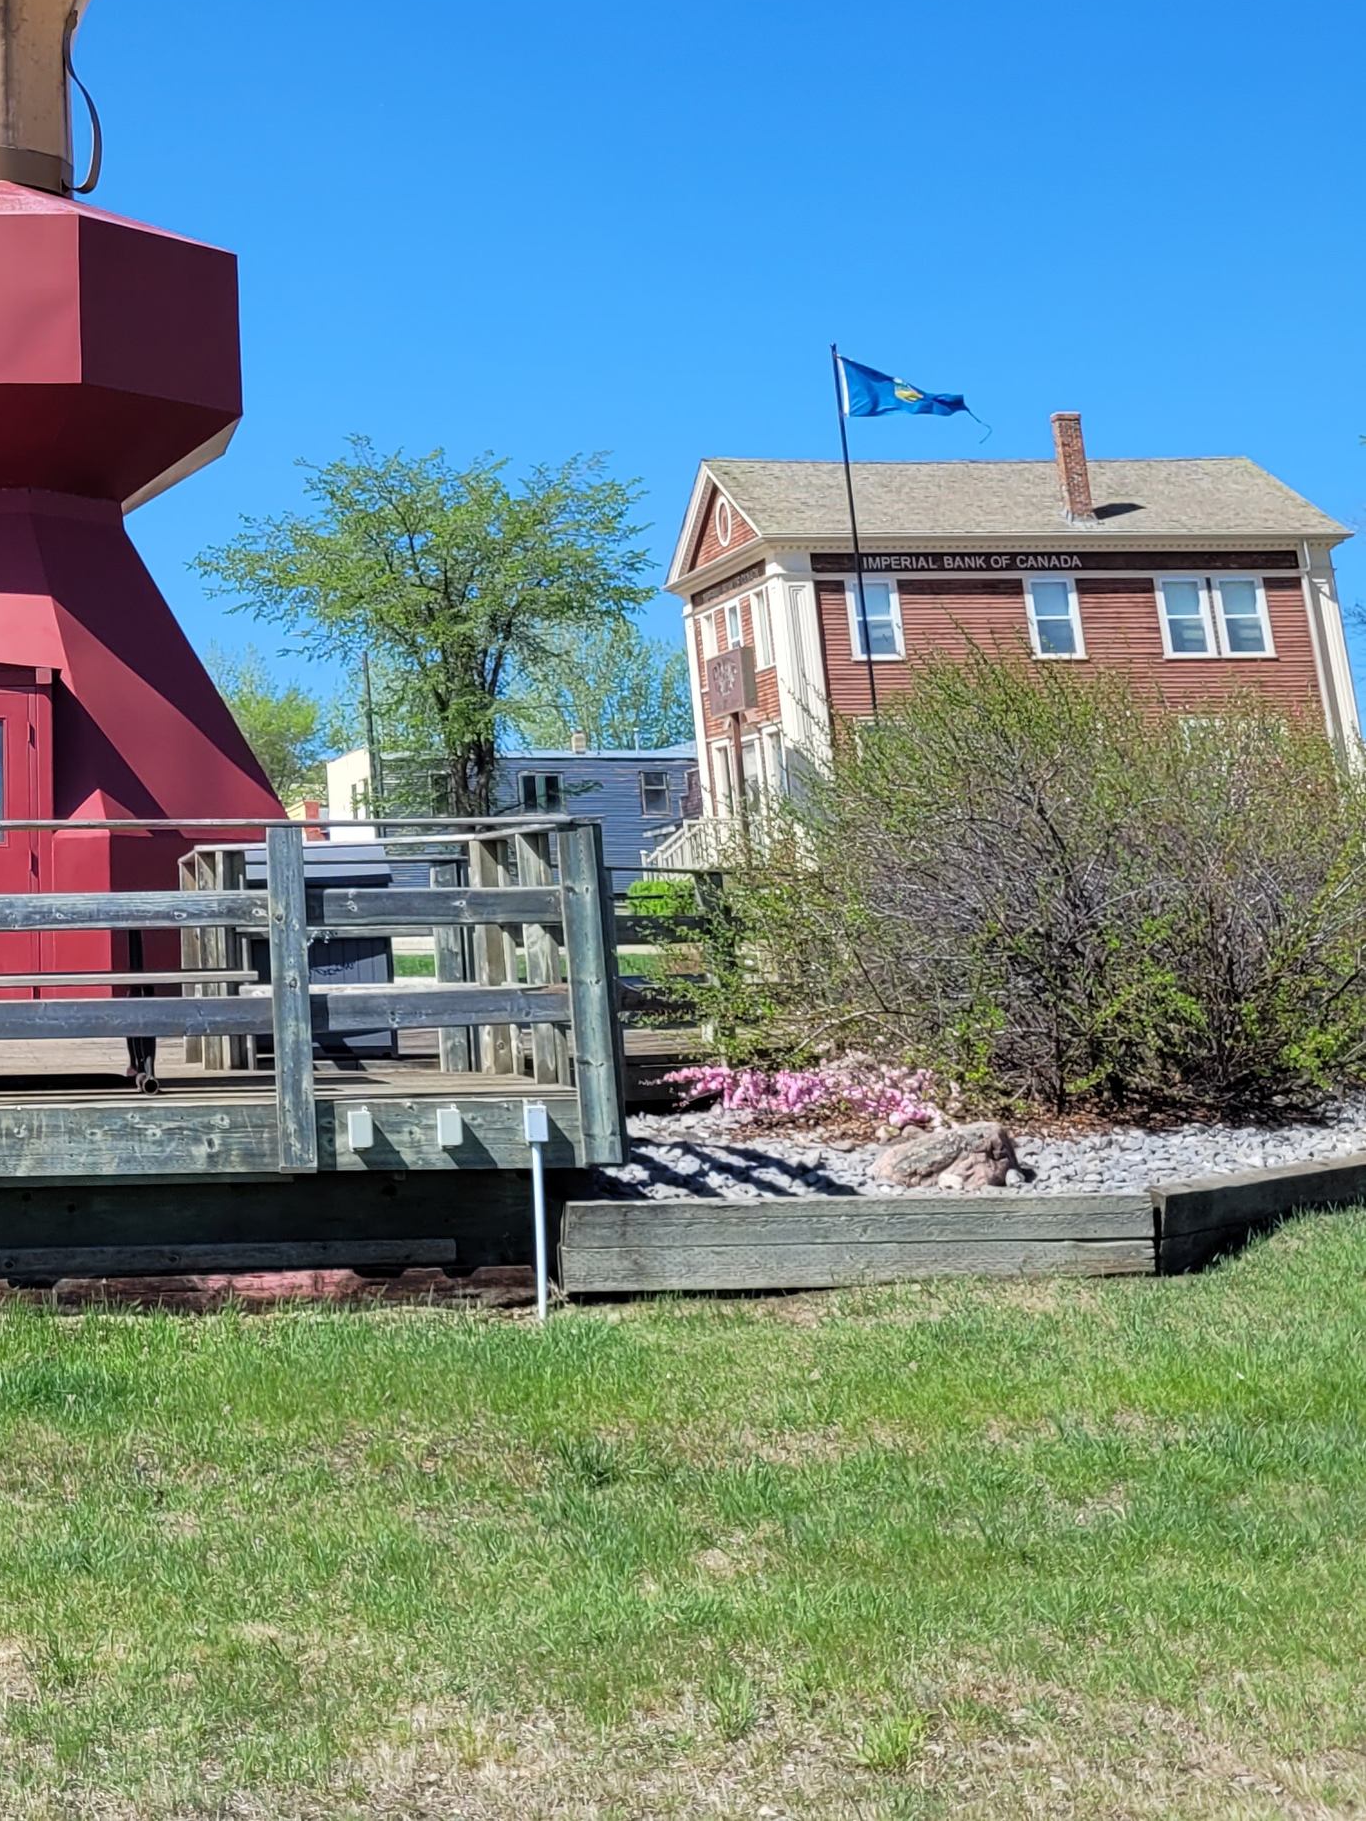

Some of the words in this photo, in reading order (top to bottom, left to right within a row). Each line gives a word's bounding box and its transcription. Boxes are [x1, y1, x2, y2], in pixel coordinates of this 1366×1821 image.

[862, 555, 938, 569] IMPERIAL
[943, 555, 987, 569] BANK
[990, 555, 1011, 568] OF
[1016, 554, 1083, 568] CANADA
